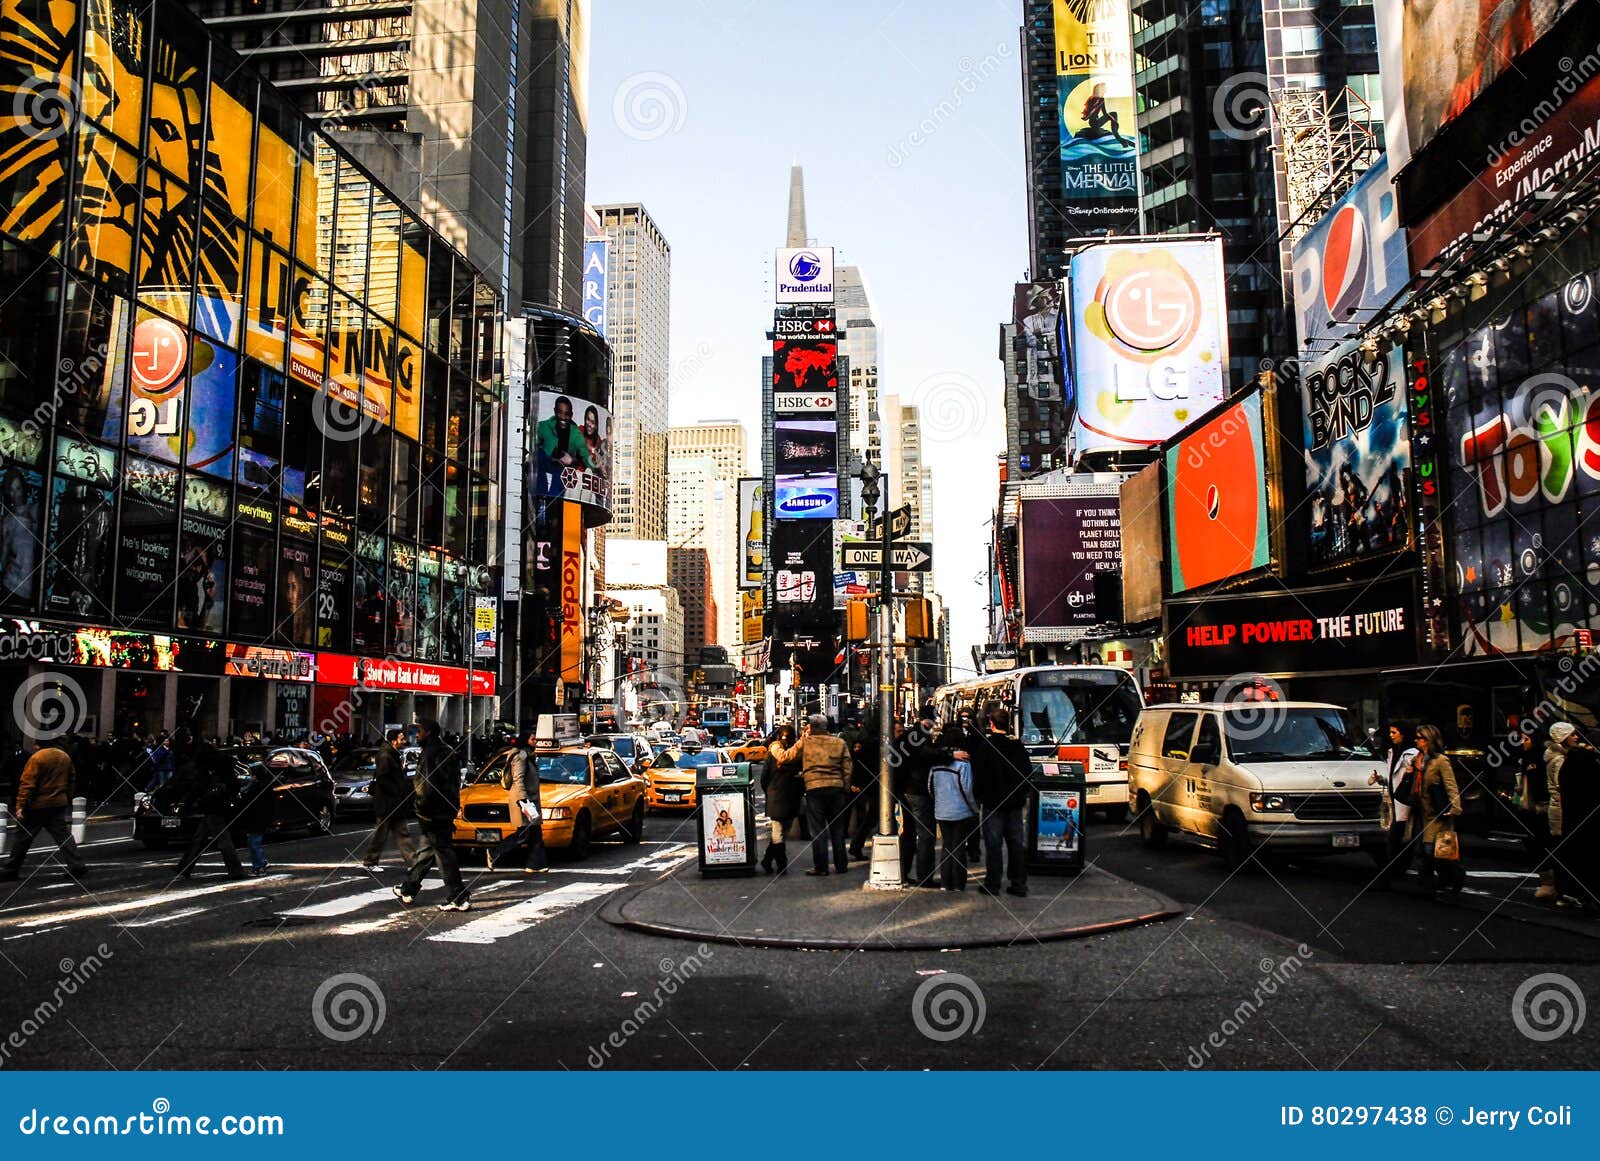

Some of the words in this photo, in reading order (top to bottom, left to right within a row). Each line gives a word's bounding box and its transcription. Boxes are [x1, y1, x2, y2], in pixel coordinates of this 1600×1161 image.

[1060, 50, 1098, 71] LION
[1083, 164, 1103, 173] THE
[1105, 162, 1135, 172] LITTLE
[1495, 134, 1553, 188] Experience
[1066, 206, 1092, 216] Disney
[780, 283, 832, 293] Prudential
[776, 320, 812, 333] HSBC
[292, 360, 323, 385] ENTRANCE
[330, 383, 340, 395] ON
[364, 399, 381, 414] STREET
[1115, 357, 1189, 402] LG
[1306, 350, 1373, 414] ROCK
[1369, 352, 1397, 408] 2
[778, 397, 813, 408] HSBC
[1308, 388, 1374, 452] BAND
[786, 498, 826, 508] SAMSUNG
[238, 503, 273, 523] everything
[1076, 509, 1083, 517] IF
[1084, 509, 1097, 517] YOU
[1098, 508, 1117, 517] THINK
[183, 519, 226, 540] BROMANCE
[1082, 519, 1109, 528] NOTHING
[325, 529, 349, 544] monday
[1079, 529, 1102, 539] PLANET
[122, 535, 140, 549] he's
[141, 539, 169, 559] looking
[1082, 540, 1099, 549] THAN
[1100, 540, 1120, 549] GREAT
[137, 552, 148, 566] for
[149, 558, 155, 567] a
[283, 546, 294, 560] THE
[295, 550, 310, 563] CITY
[854, 551, 878, 562] ONE
[895, 551, 920, 563] WAY
[1072, 551, 1085, 560] YOU
[1087, 551, 1102, 560] NEED
[1104, 551, 1113, 559] TO
[1095, 561, 1110, 570] NEW
[320, 568, 345, 585] monday
[562, 550, 580, 637] Kodak
[1186, 624, 1236, 647] HELP
[1242, 619, 1313, 644] POWER
[1317, 615, 1352, 640] THE
[1355, 607, 1405, 637] FUTURE
[250, 653, 301, 677] element
[367, 663, 384, 681] show
[384, 669, 397, 686] your
[398, 665, 412, 684] Bank
[412, 667, 419, 685] of
[420, 668, 440, 687] America
[277, 684, 307, 699] POWER
[287, 700, 298, 711] TO
[286, 714, 300, 725] THE
